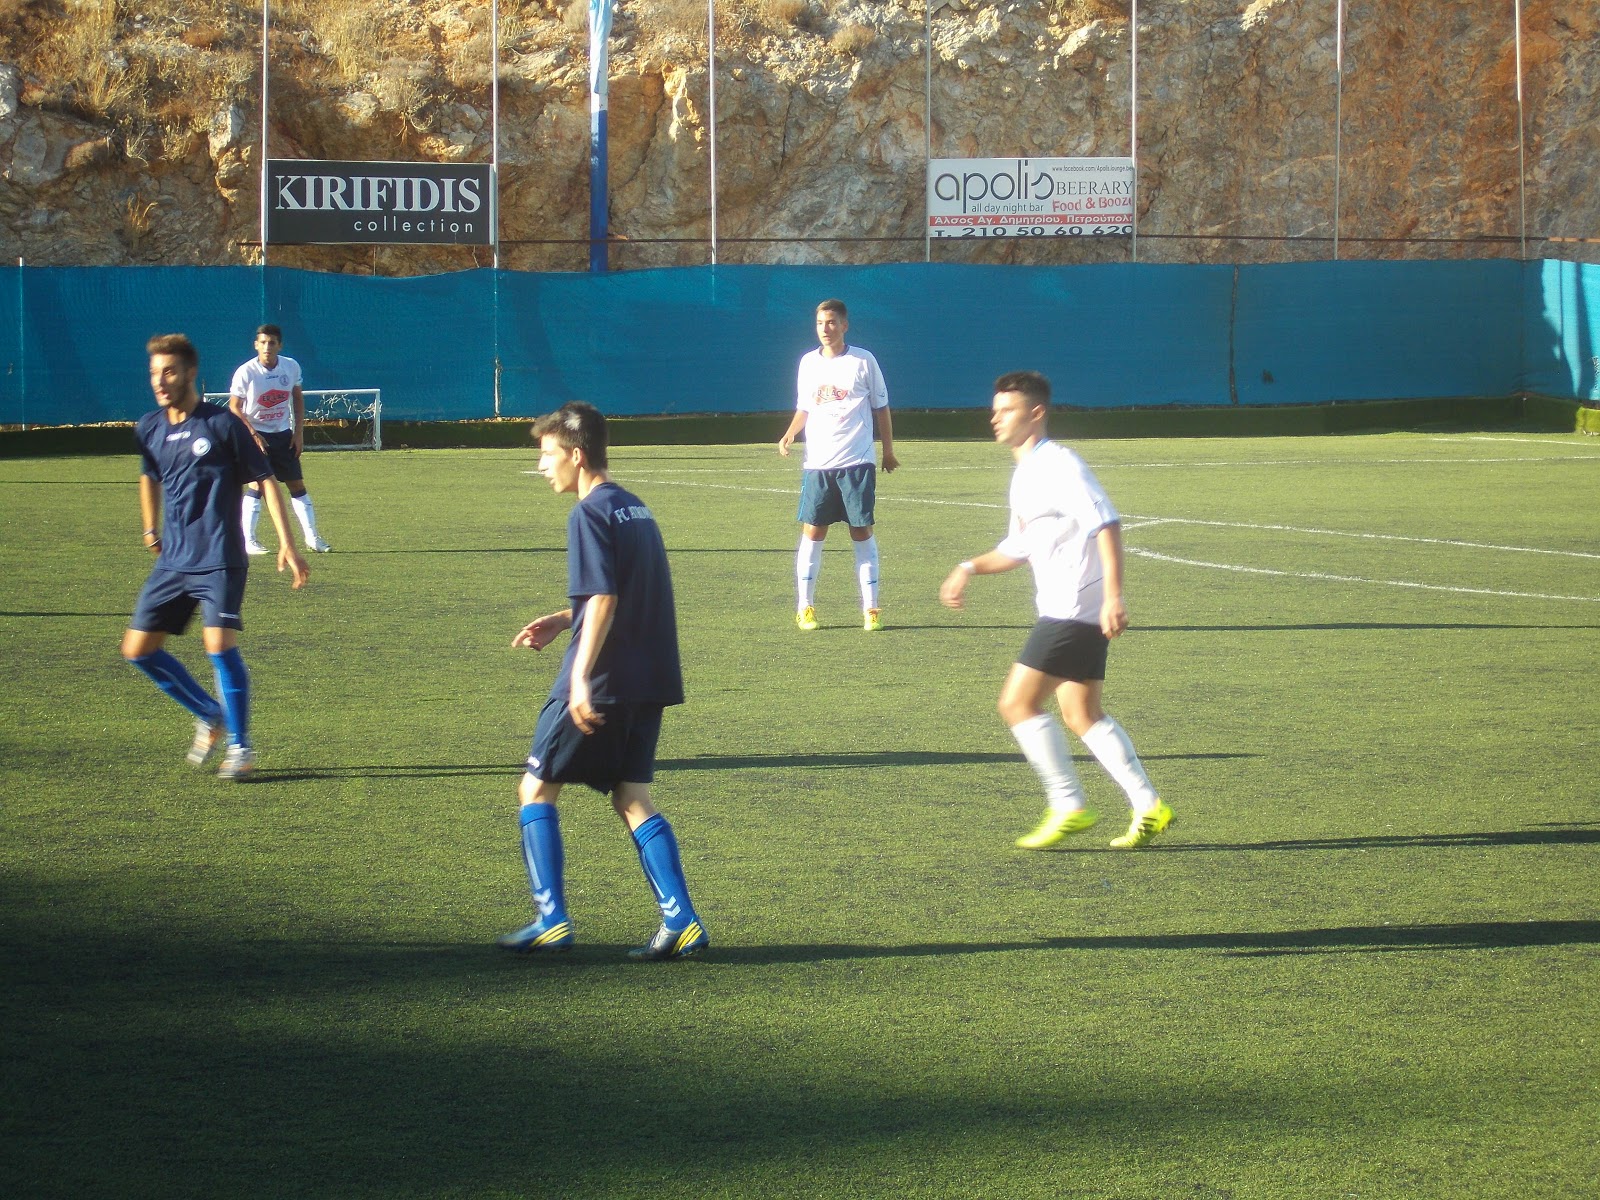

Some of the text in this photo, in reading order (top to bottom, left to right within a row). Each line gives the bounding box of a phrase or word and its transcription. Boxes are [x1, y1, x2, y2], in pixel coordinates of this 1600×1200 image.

[275, 175, 481, 213] KIRIFIDIS
[934, 159, 1055, 214] apolis
[1056, 181, 1133, 195] BEERARY
[971, 202, 1044, 214] all day night bar
[1052, 199, 1082, 212] Food
[1085, 197, 1096, 209] &
[354, 215, 473, 233] collection
[934, 216, 974, 225] Άλσος
[999, 214, 1063, 225] Δημητρίου,
[962, 226, 1007, 236] 210
[1015, 226, 1045, 236] 50
[1054, 225, 1083, 235] 60
[1092, 225, 1133, 235] 620
[613, 507, 630, 524] FC
